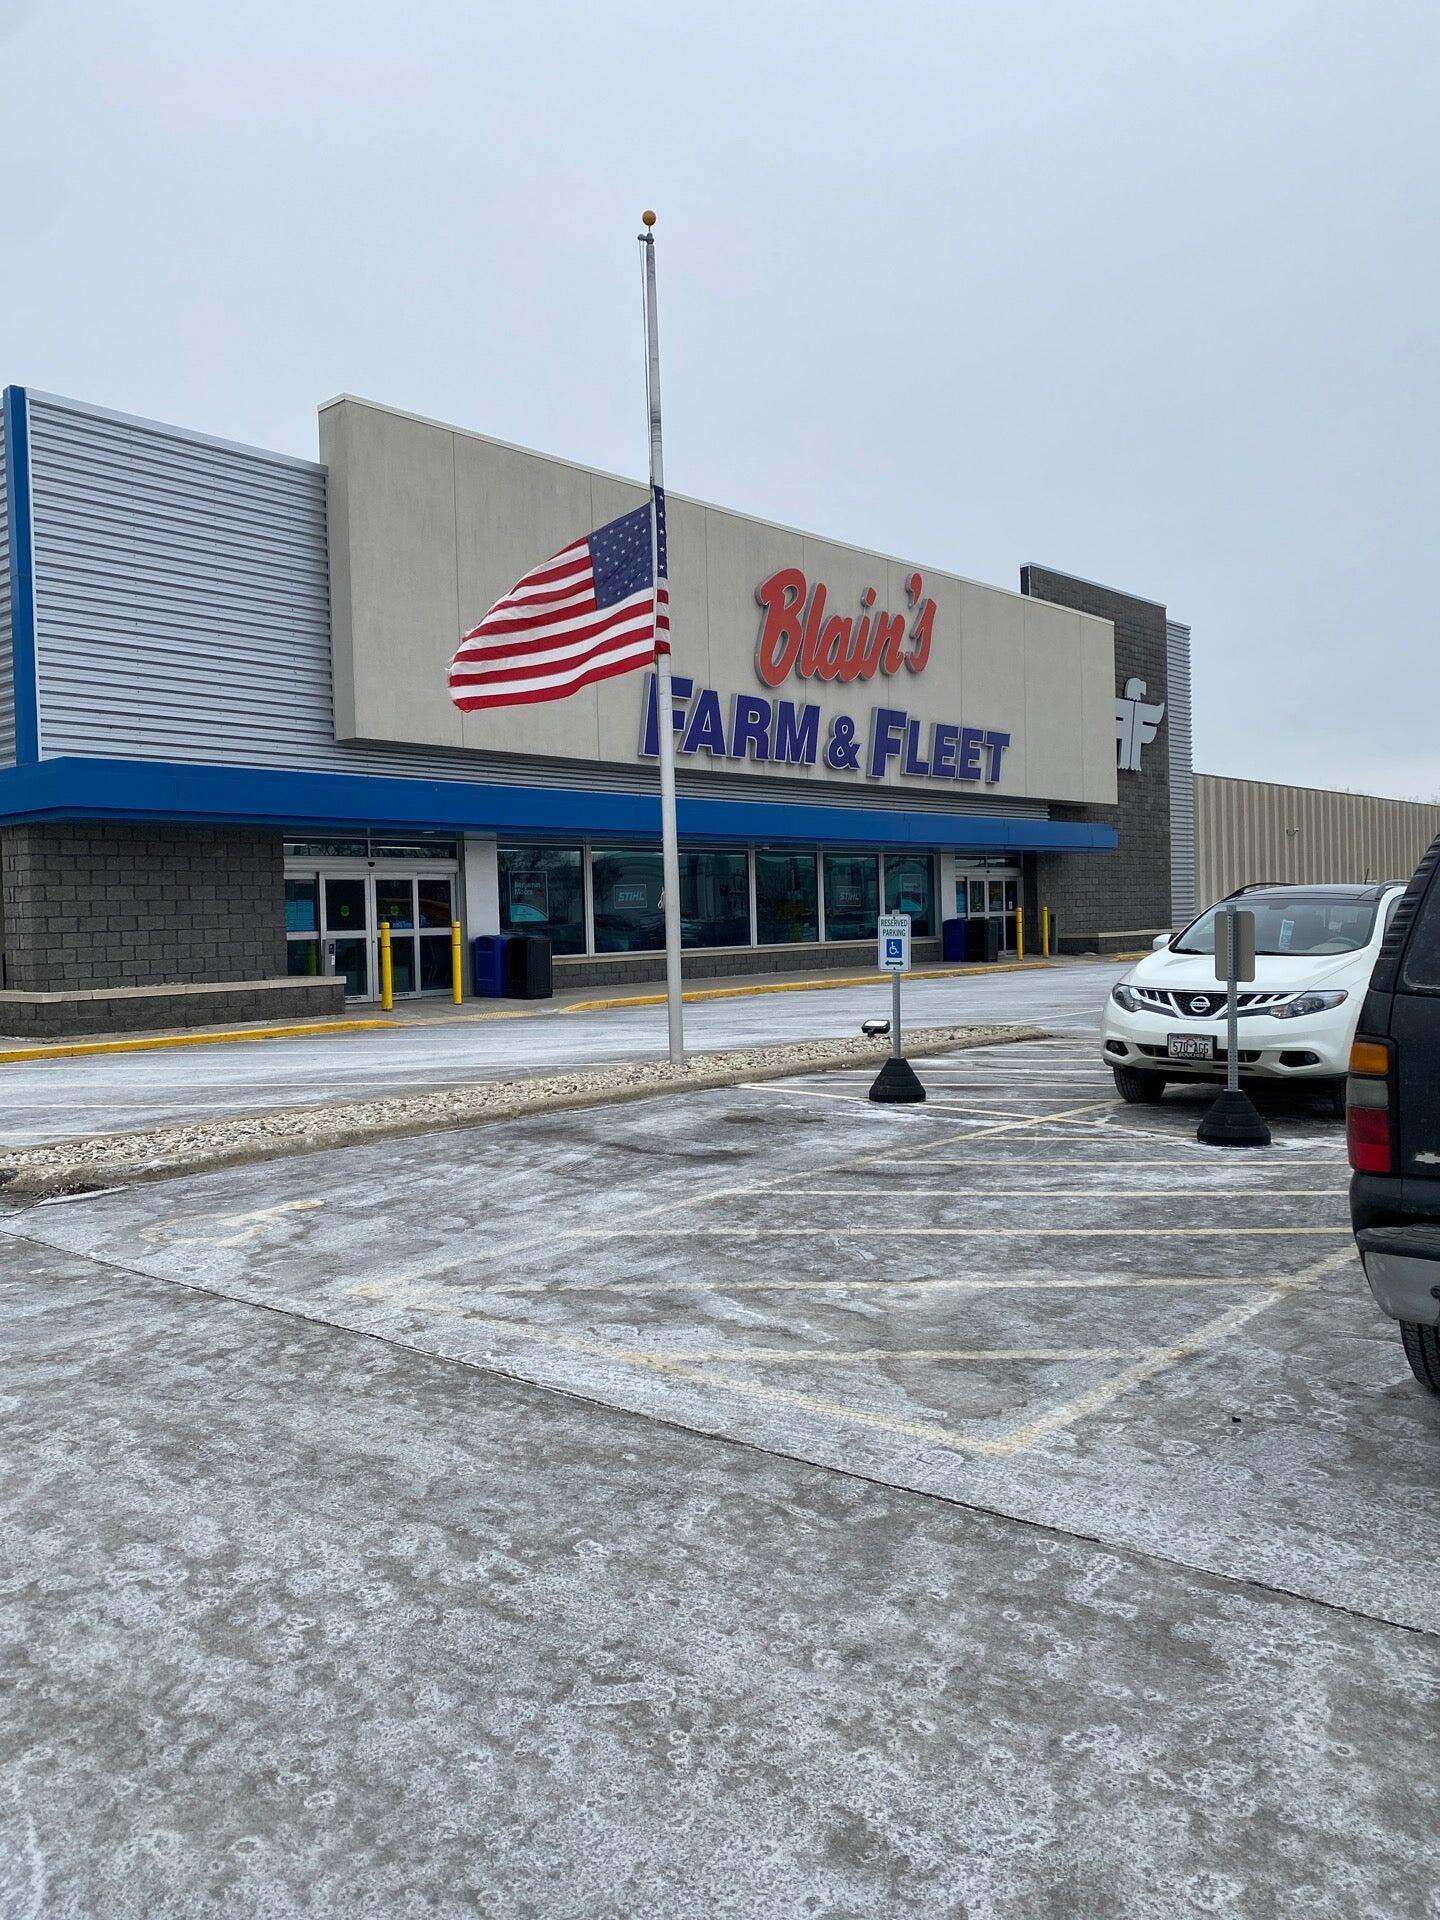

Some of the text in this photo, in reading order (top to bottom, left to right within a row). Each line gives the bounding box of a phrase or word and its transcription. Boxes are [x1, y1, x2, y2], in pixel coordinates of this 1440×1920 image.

[755, 568, 937, 687] Blain's
[639, 672, 1011, 783] FARM & FLEET
[618, 890, 644, 901] STIHL
[881, 919, 907, 927] RESERVED
[882, 929, 906, 937] PARKING
